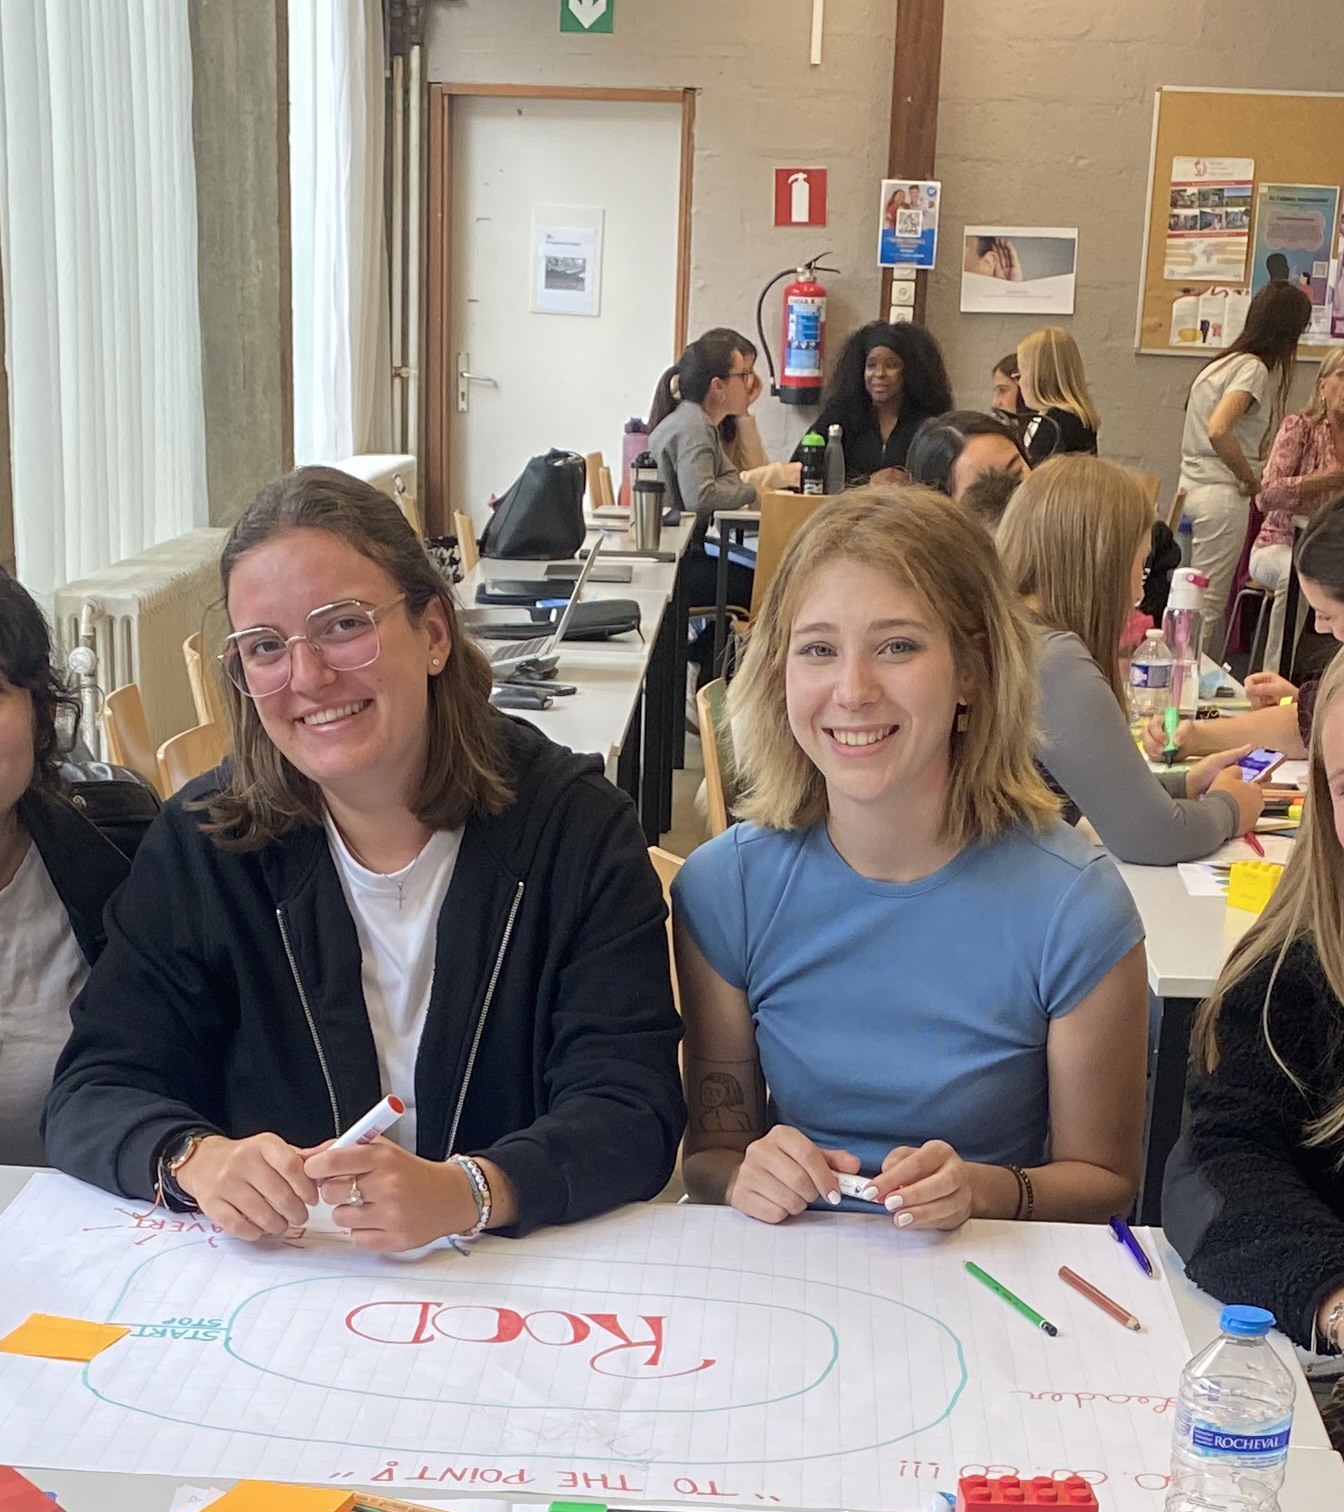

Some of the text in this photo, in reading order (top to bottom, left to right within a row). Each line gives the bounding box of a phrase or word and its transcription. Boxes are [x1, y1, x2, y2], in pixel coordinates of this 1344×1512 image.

[161, 1316, 224, 1328] STOP
[130, 1326, 219, 1342] START
[1214, 1435, 1279, 1449] ROCHEVAL
[557, 1470, 643, 1492] THE
[673, 1477, 739, 1496] TO
